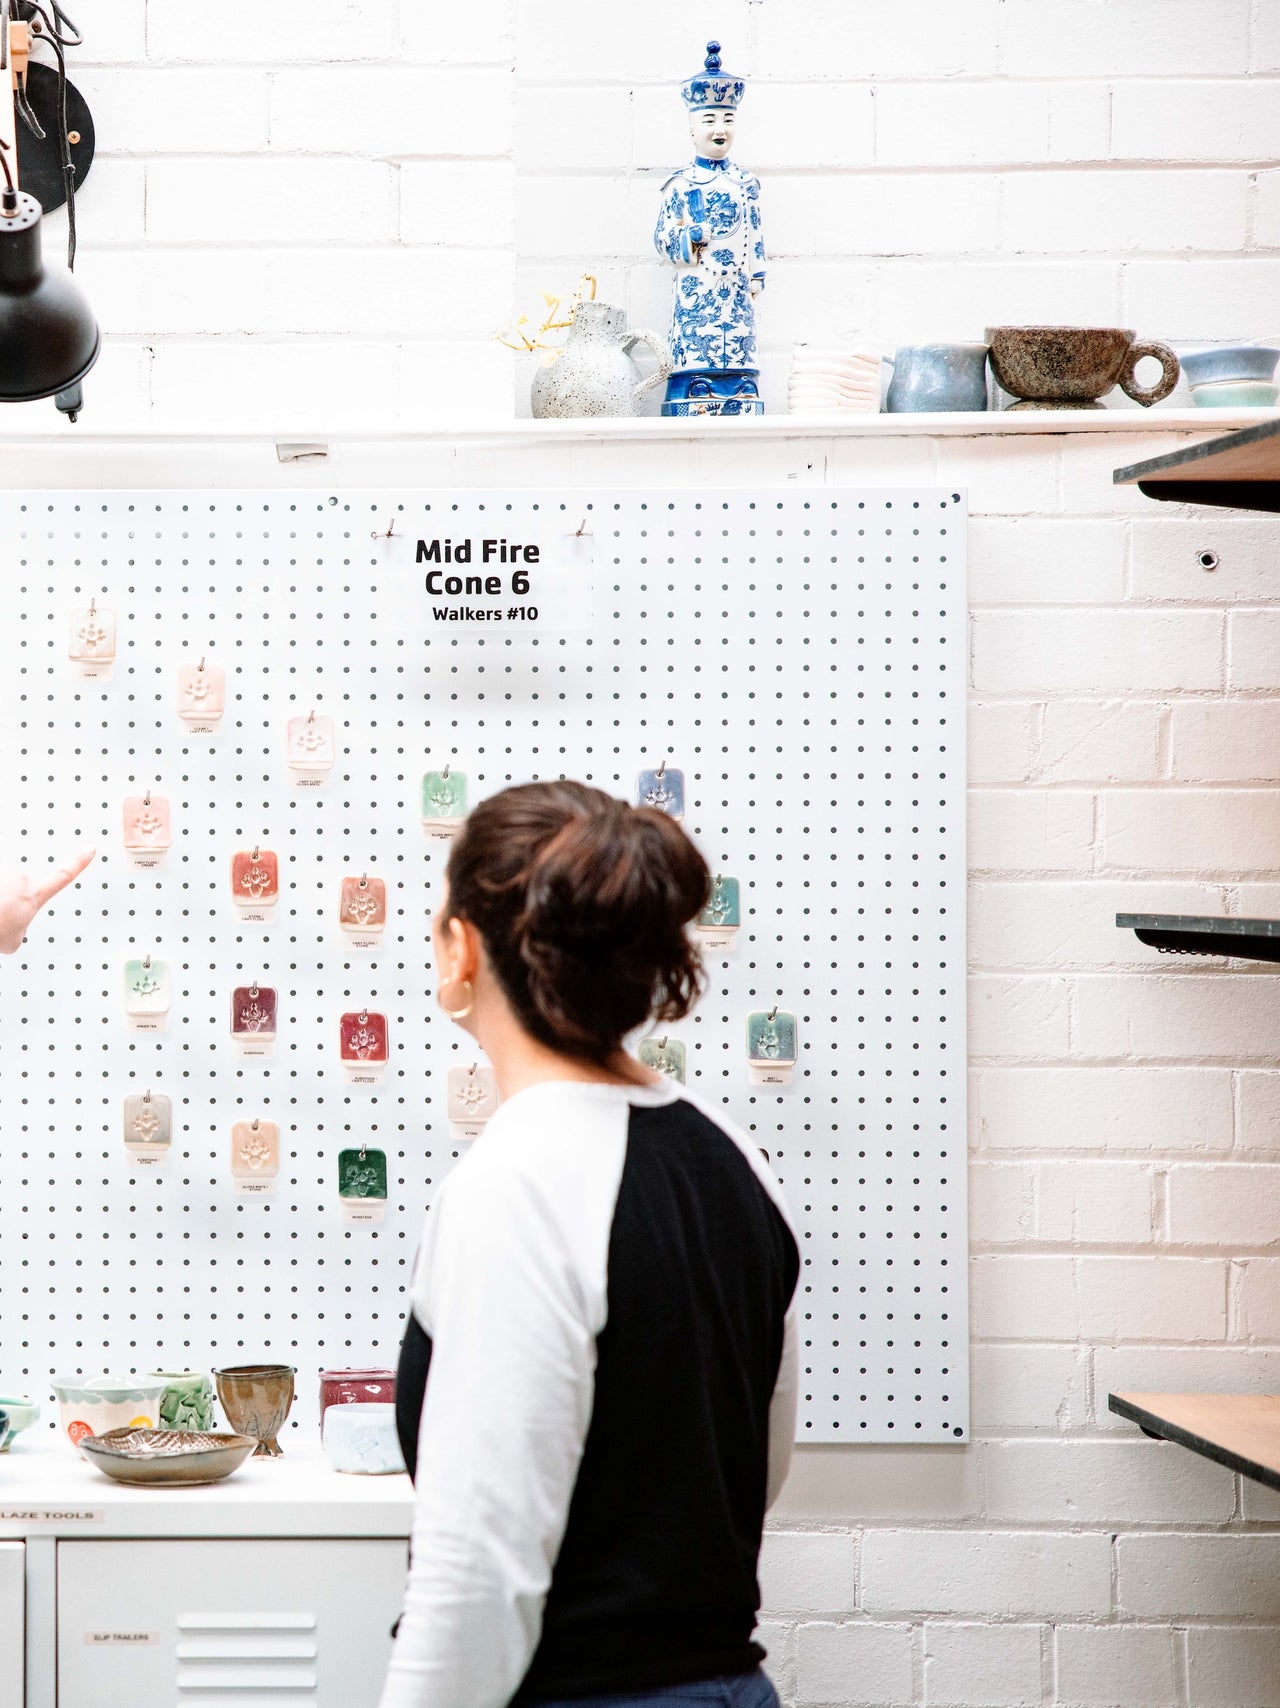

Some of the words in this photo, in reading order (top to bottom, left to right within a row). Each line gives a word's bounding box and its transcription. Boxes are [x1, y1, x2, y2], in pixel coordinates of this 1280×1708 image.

[416, 539, 471, 563] Mid
[482, 539, 540, 563] Fire
[425, 570, 502, 595] Cone
[511, 570, 530, 595] 6
[432, 606, 502, 621] Walkers
[507, 606, 539, 621] #10
[43, 1511, 94, 1519] TOOLS
